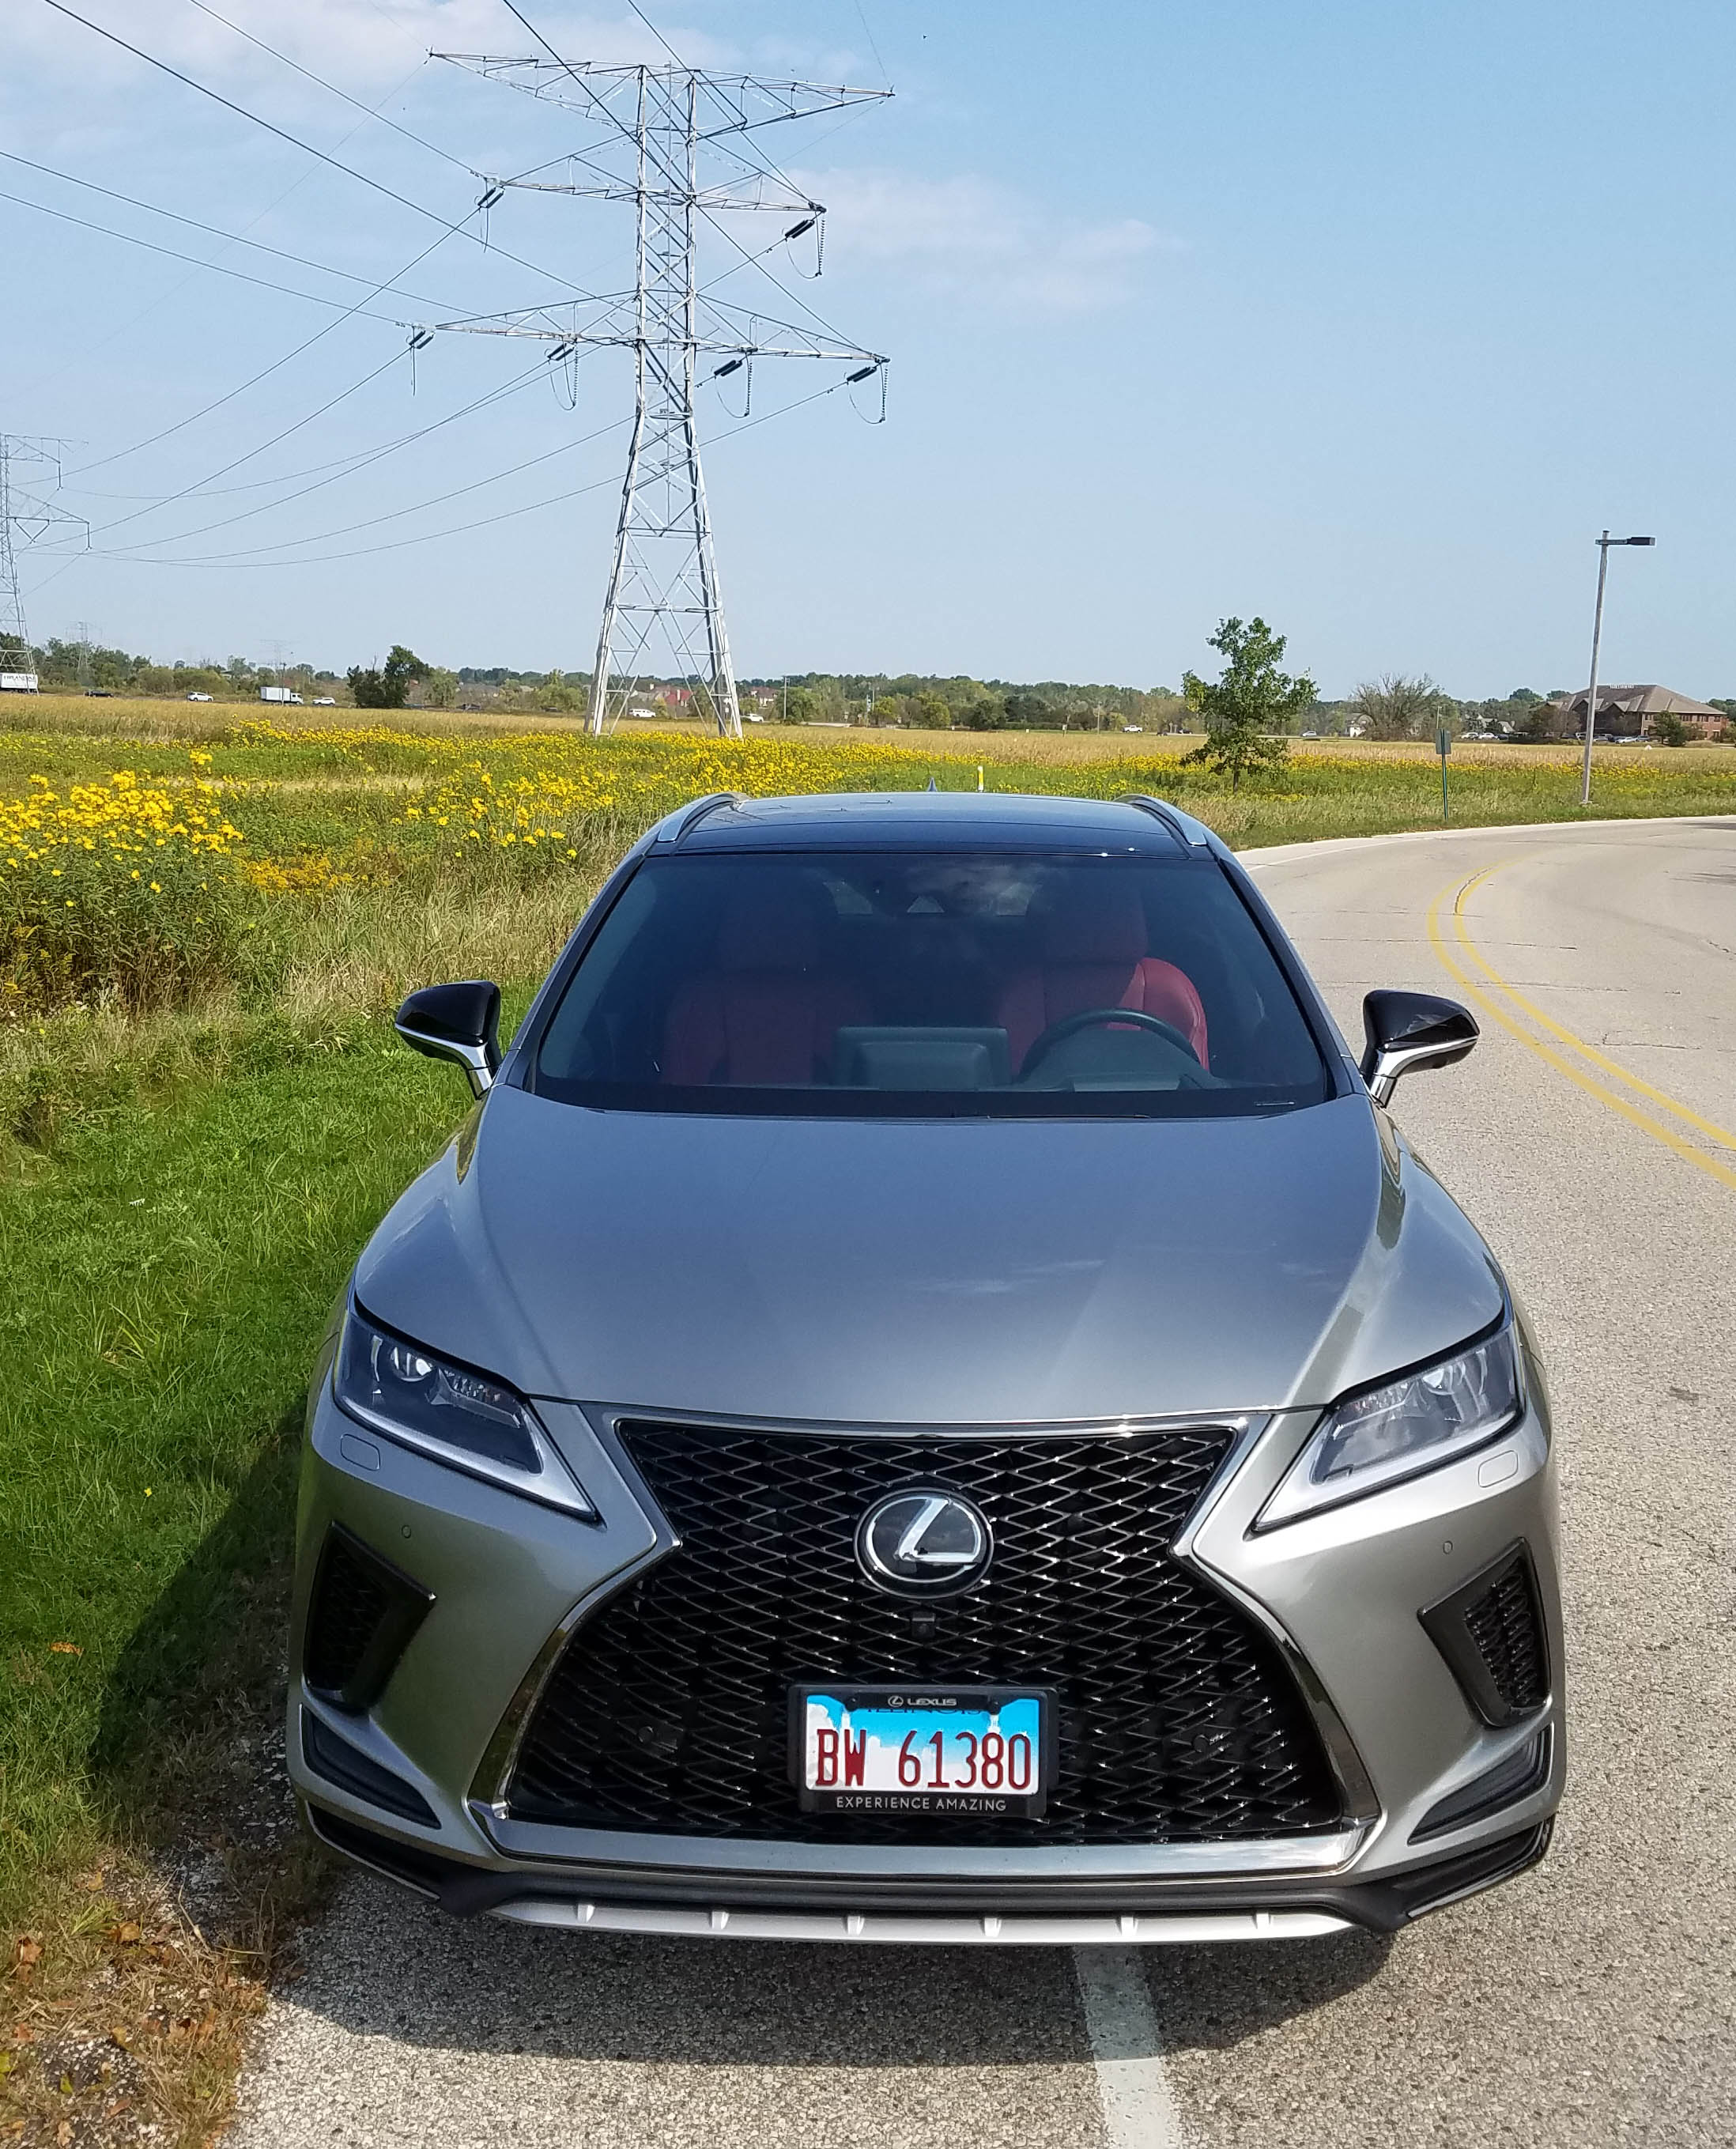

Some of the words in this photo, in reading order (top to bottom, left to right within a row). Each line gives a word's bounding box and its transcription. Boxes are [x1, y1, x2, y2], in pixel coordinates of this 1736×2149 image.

[907, 1698, 957, 1706] LEXUS
[815, 1728, 867, 1787] BW
[898, 1729, 1032, 1790] 61380
[836, 1796, 930, 1810] EXPERIENCE
[935, 1798, 1007, 1812] AMAZING
